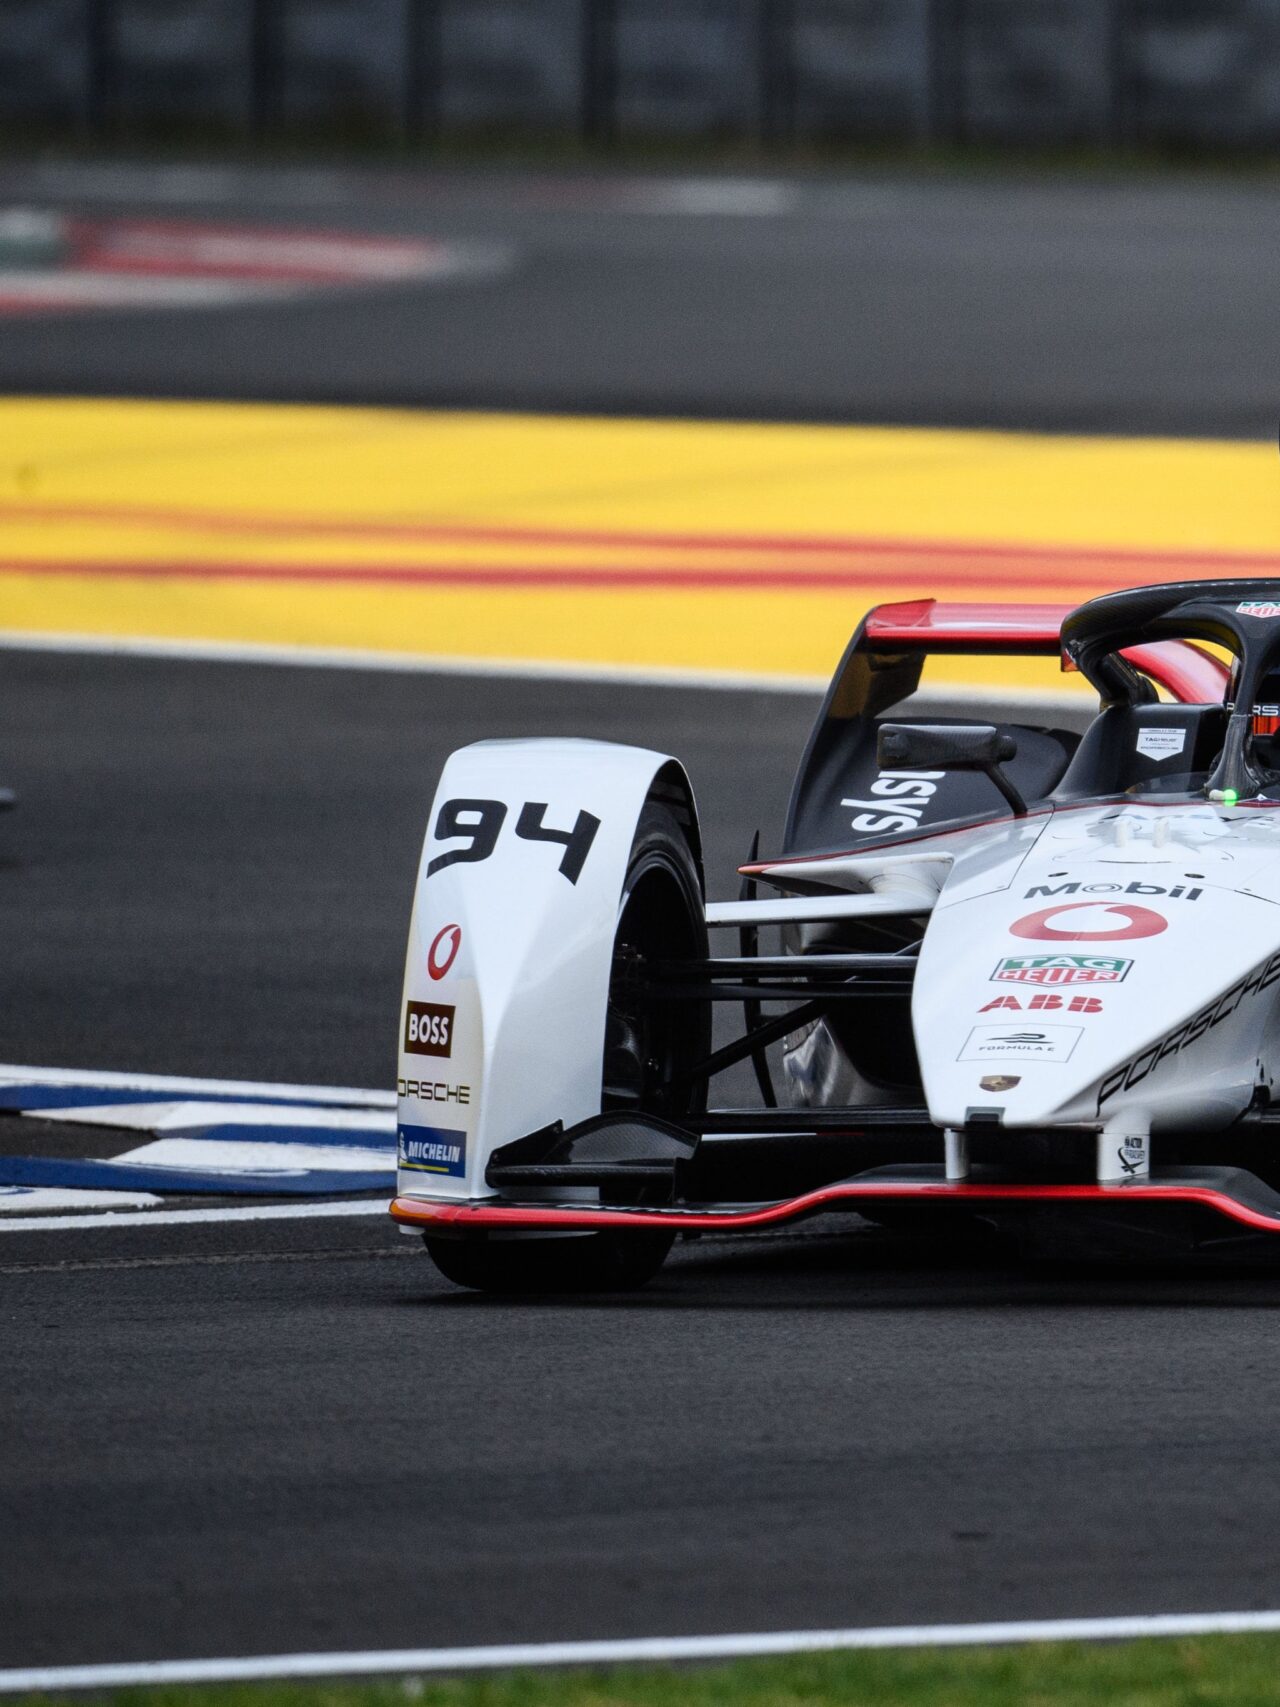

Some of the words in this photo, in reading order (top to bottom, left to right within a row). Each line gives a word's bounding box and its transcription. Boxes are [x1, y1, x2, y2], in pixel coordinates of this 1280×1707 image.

[426, 798, 602, 886] 94
[1023, 882, 1204, 901] Mobil
[1011, 956, 1119, 970] TAG
[1000, 968, 1117, 985] HEUER
[976, 994, 1104, 1013] ABB
[408, 1013, 449, 1046] BOSS
[978, 1044, 1043, 1052] FORMULA
[398, 1078, 471, 1105] ORSCHE
[408, 1140, 461, 1163] MICHELIN
